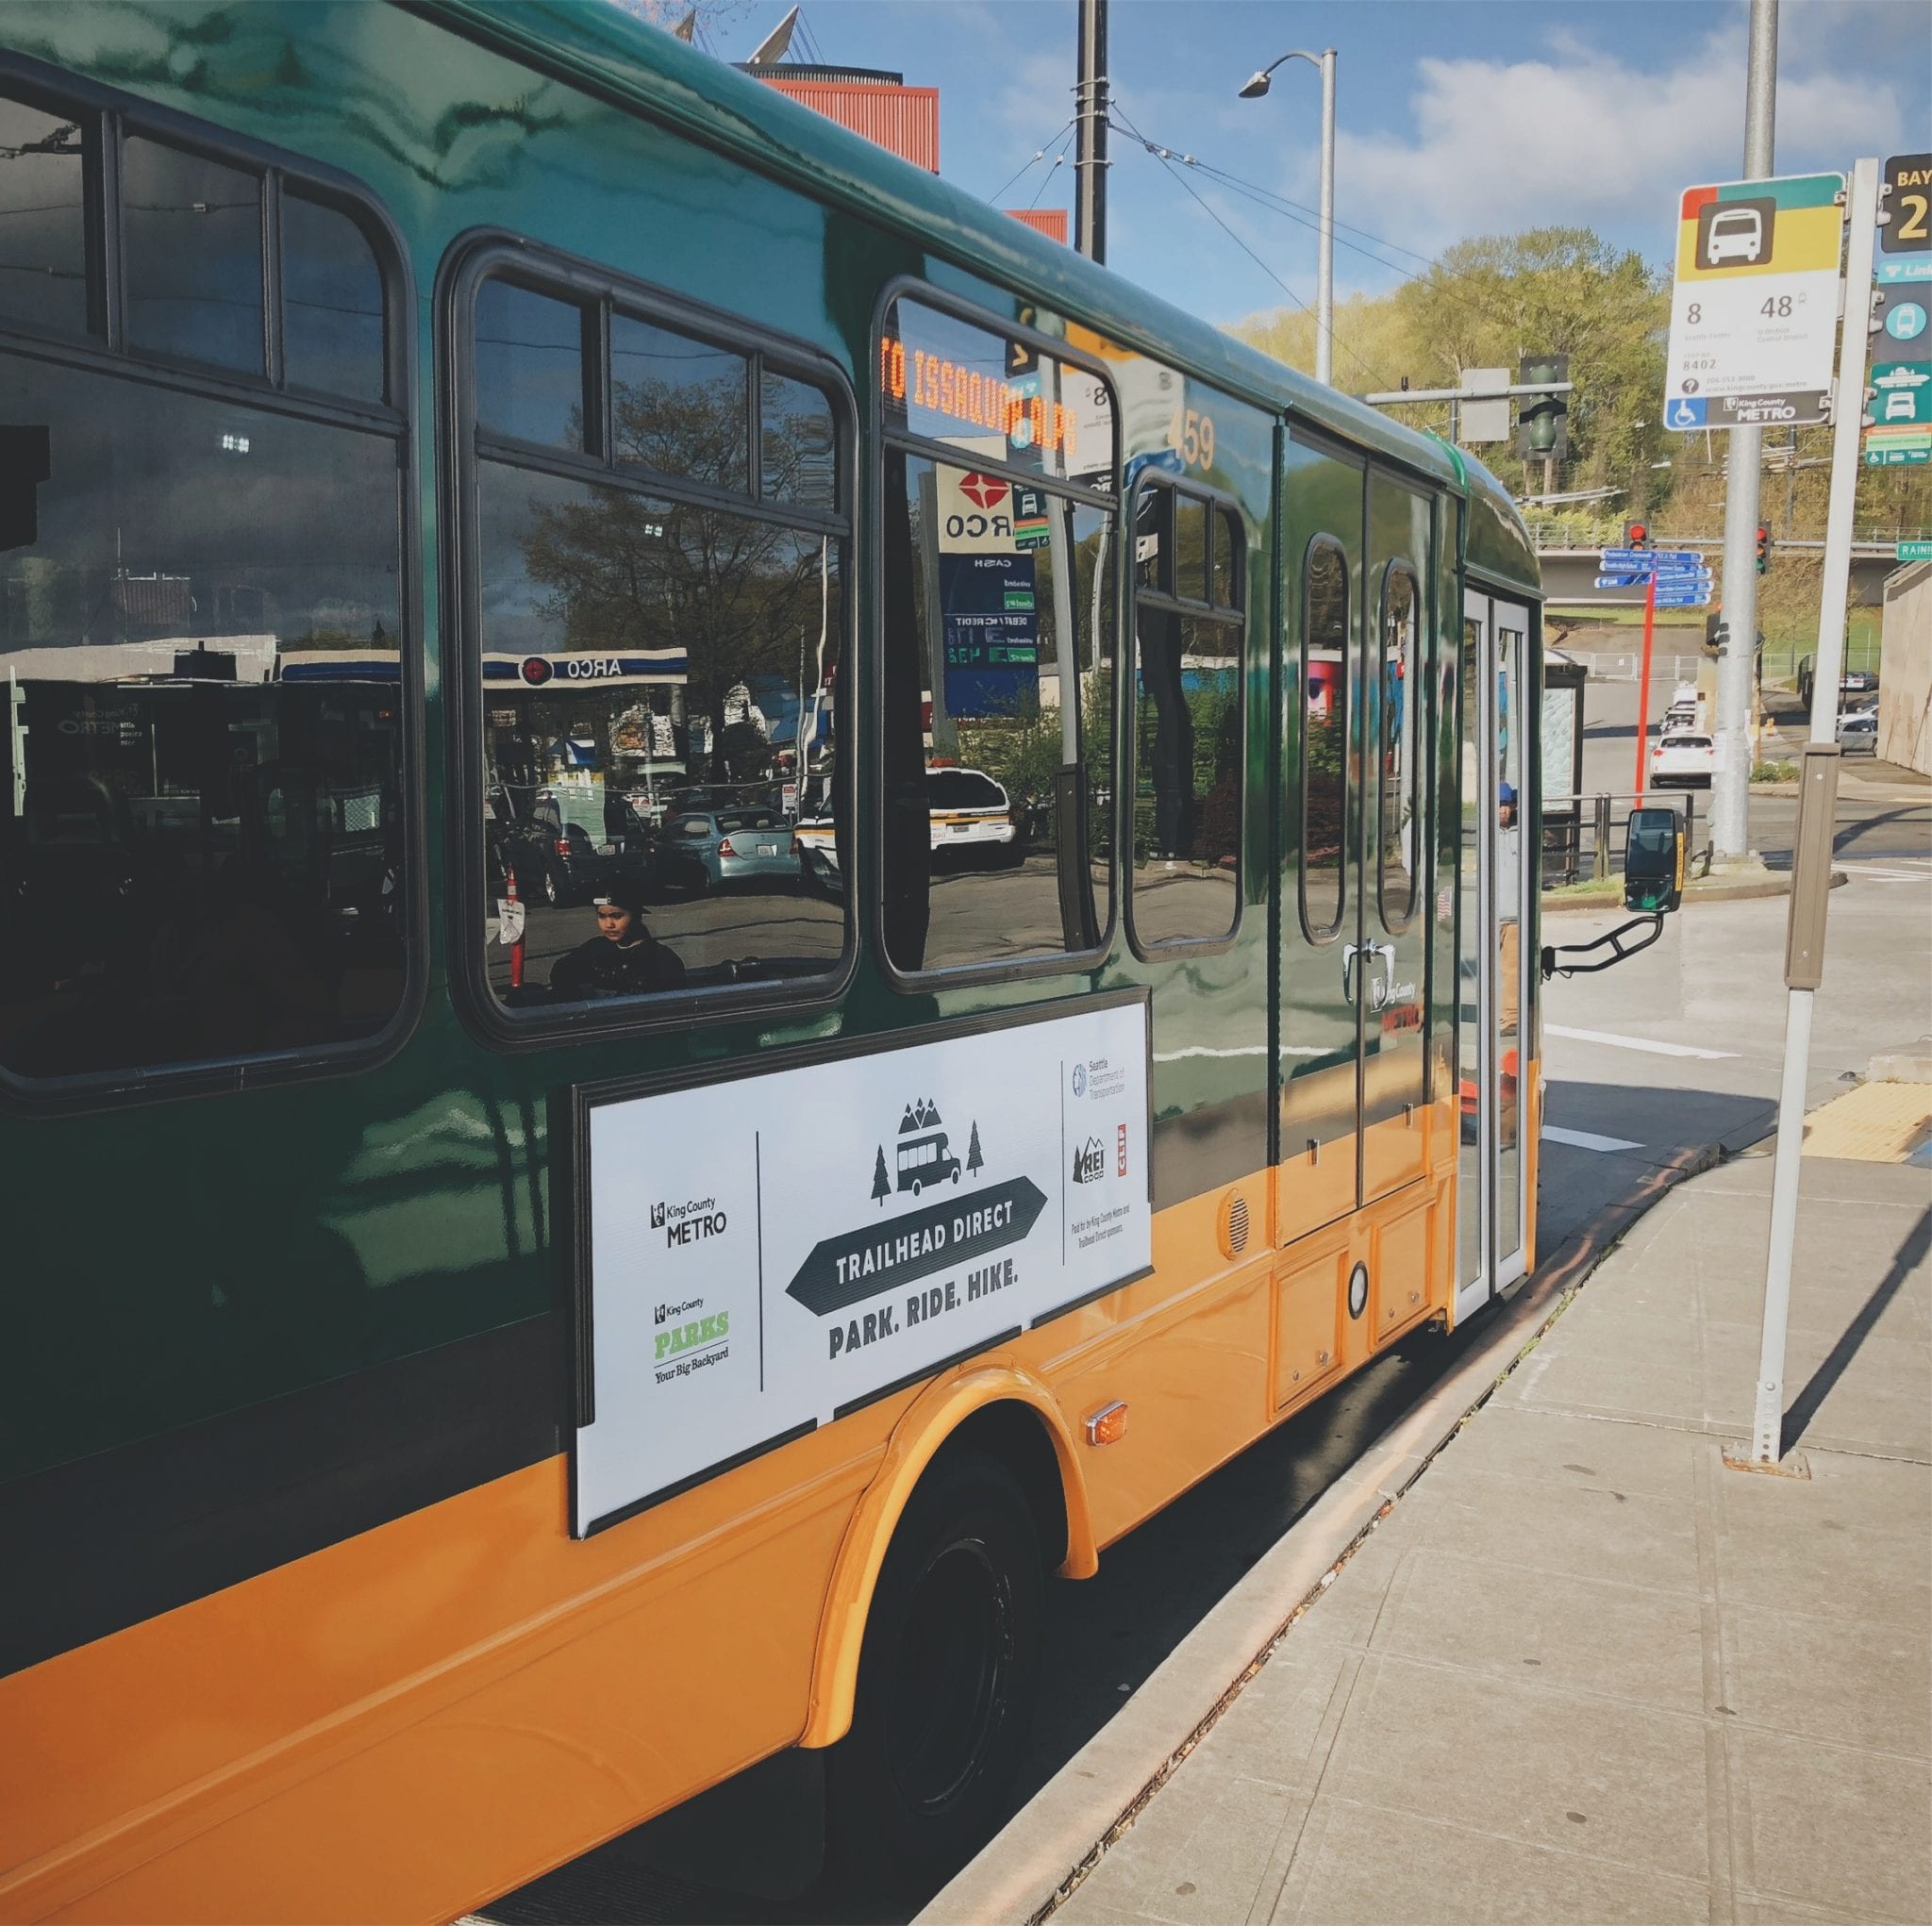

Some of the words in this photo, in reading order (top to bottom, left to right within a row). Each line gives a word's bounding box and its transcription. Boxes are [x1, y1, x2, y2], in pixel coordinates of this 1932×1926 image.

[1898, 170, 1932, 187] BAY
[1898, 194, 1928, 240] 2
[1687, 303, 1702, 324] 8
[1760, 295, 1792, 318] 48
[1683, 359, 1716, 371] 8402
[1738, 399, 1757, 408] King
[1757, 398, 1787, 407] County
[1737, 406, 1796, 422] METRO
[1902, 545, 1932, 556] RAINI
[1396, 981, 1415, 1000] County
[1089, 1058, 1108, 1071] Seattle
[1089, 1071, 1119, 1087] Department
[1089, 1084, 1125, 1101] Transportation
[1083, 1149, 1104, 1175] REI
[666, 1205, 686, 1219] King
[687, 1197, 716, 1214] County
[667, 1211, 727, 1249] METRO
[836, 1224, 946, 1284] TRAILHEAD
[953, 1200, 1012, 1243] DIRECT
[666, 1305, 681, 1318] King
[681, 1298, 705, 1312] County
[829, 1305, 900, 1360] PARK.
[907, 1281, 961, 1328] RIDE.
[968, 1257, 1019, 1302] HIKE.
[654, 1310, 730, 1360] PARKS
[655, 1369, 676, 1385] Your
[676, 1362, 691, 1377] Big
[691, 1347, 729, 1370] Backyard
